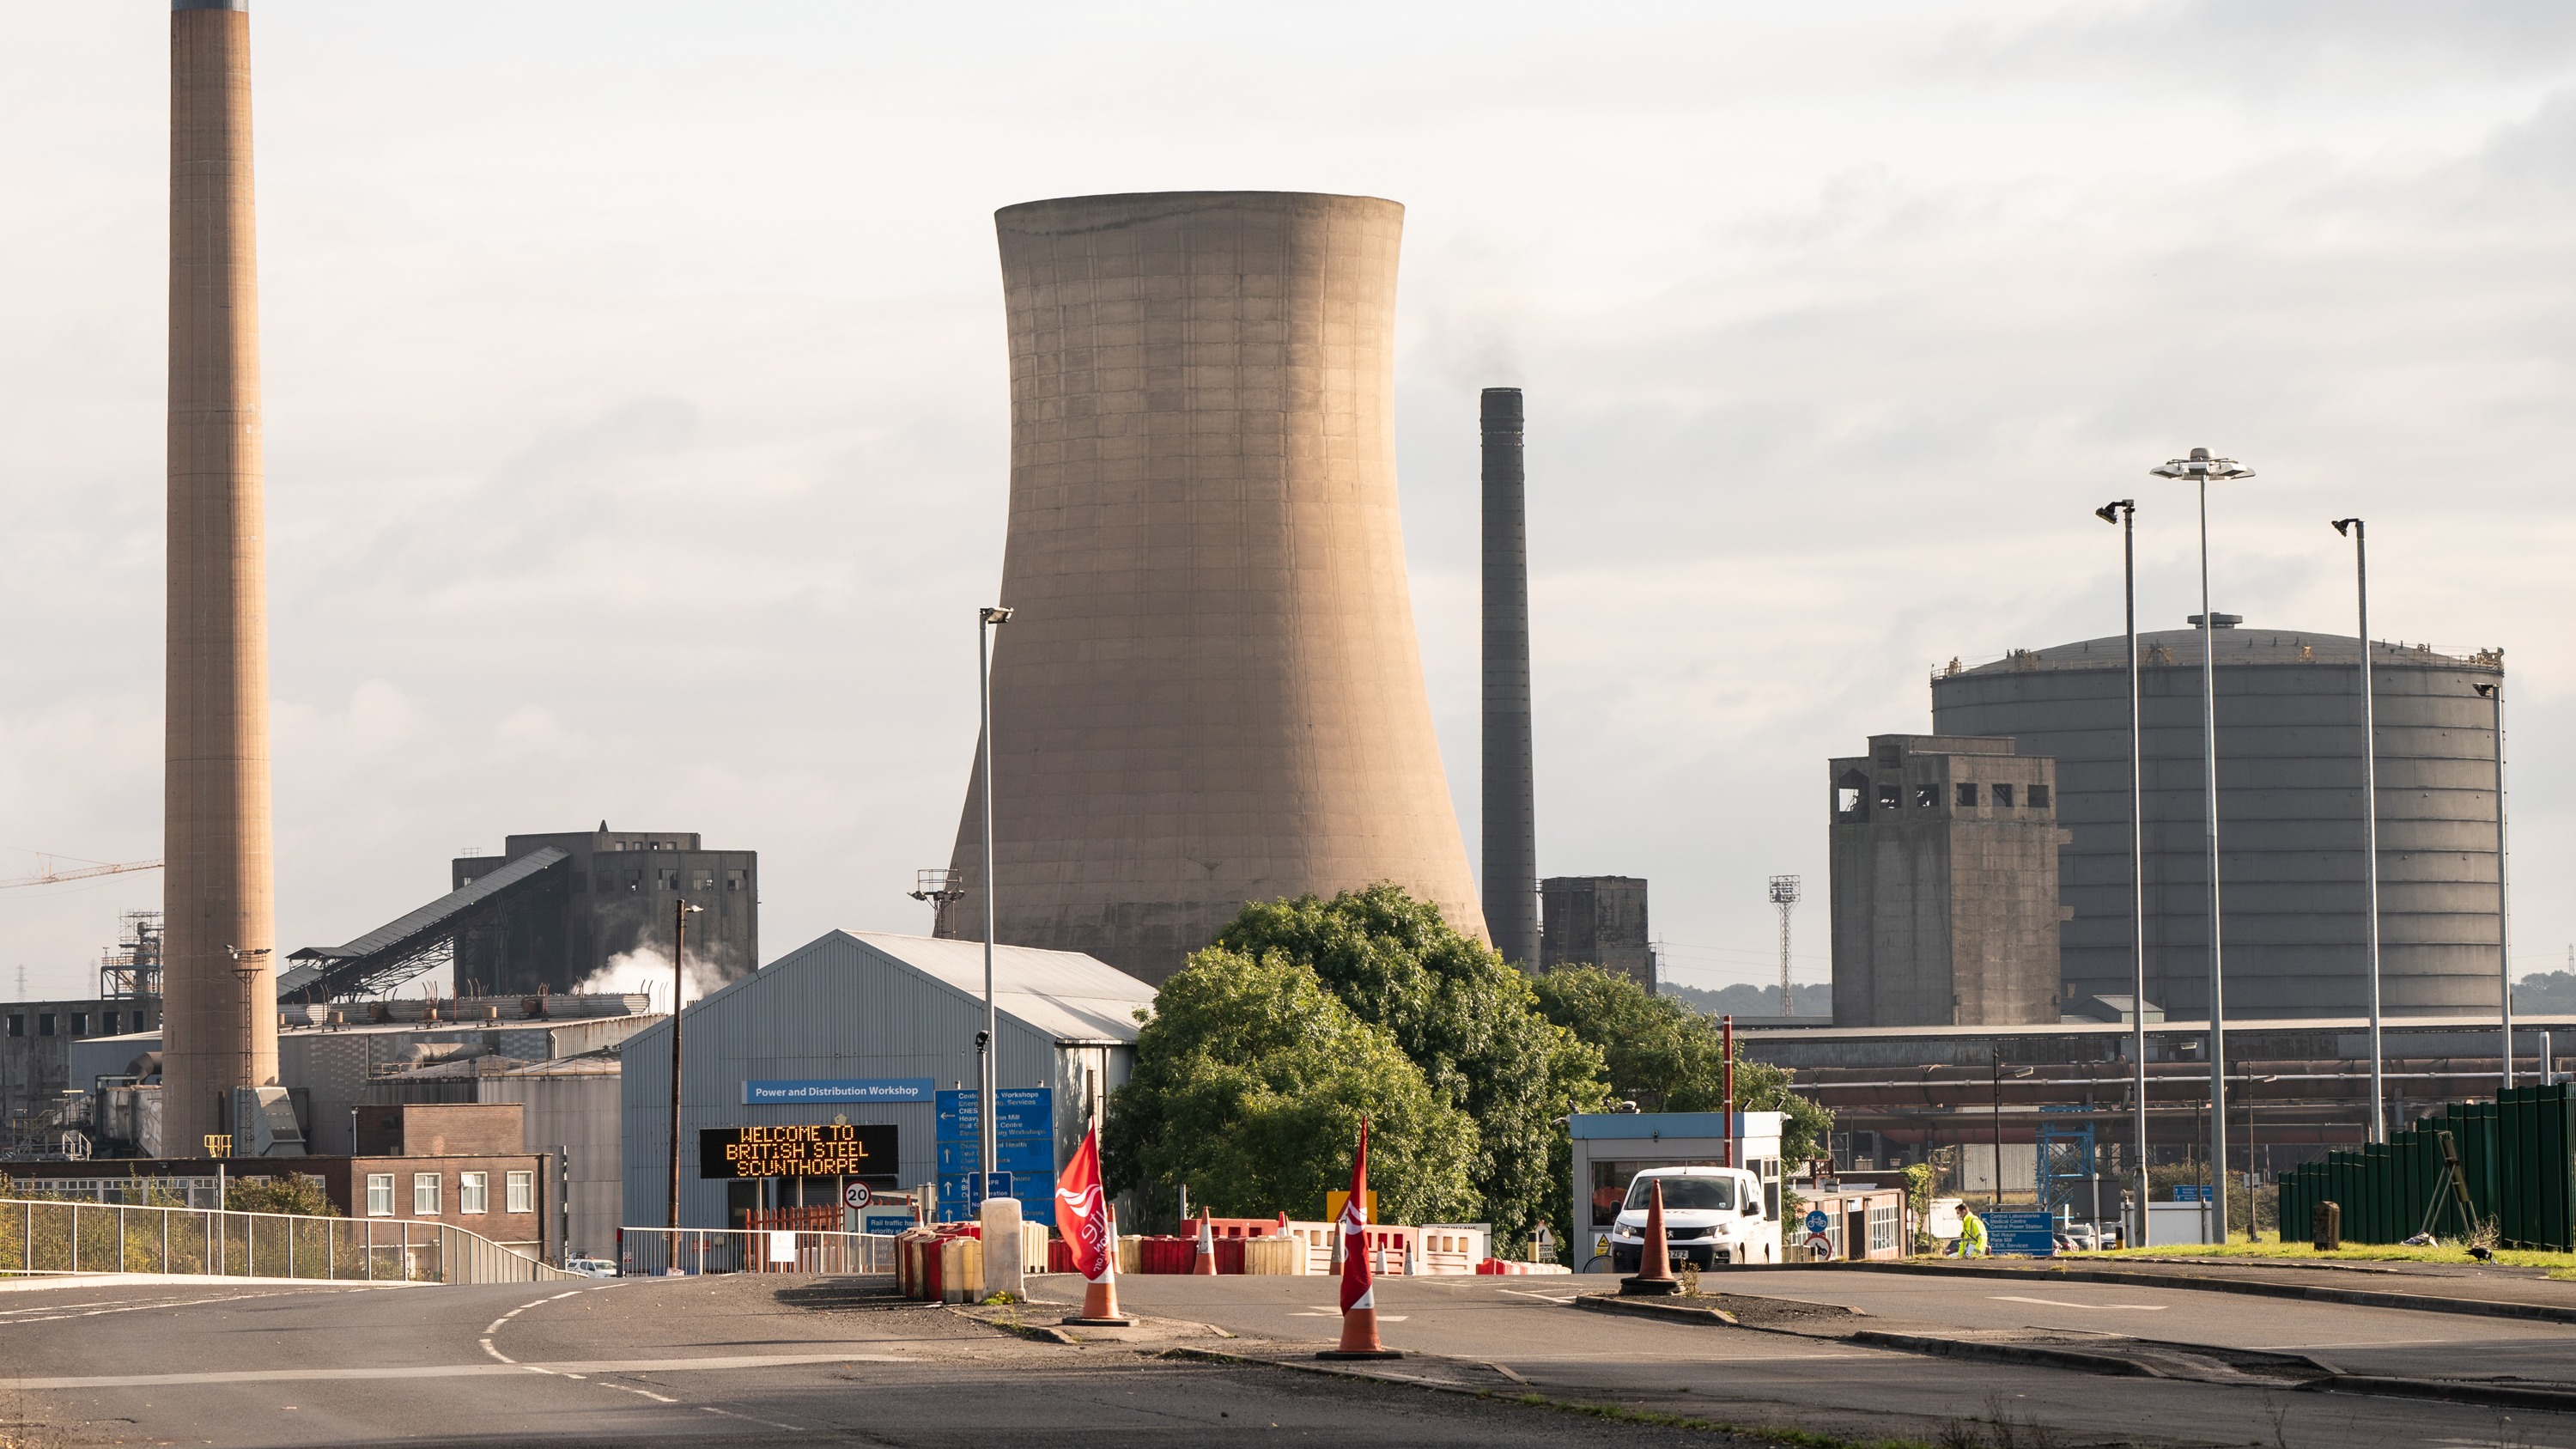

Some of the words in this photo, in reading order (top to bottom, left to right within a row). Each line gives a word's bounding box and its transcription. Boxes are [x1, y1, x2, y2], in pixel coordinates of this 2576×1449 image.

[756, 1087, 787, 1097] Power
[787, 1087, 806, 1096] and
[808, 1086, 867, 1096] Distribution
[868, 1085, 919, 1097] Workshop
[741, 1125, 821, 1143] WELCOME
[829, 1124, 854, 1141] TO
[726, 1142, 805, 1160] BRITISH
[813, 1141, 869, 1158] STEEL
[737, 1158, 859, 1177] SCUNTHORPE
[848, 1189, 867, 1201] 20
